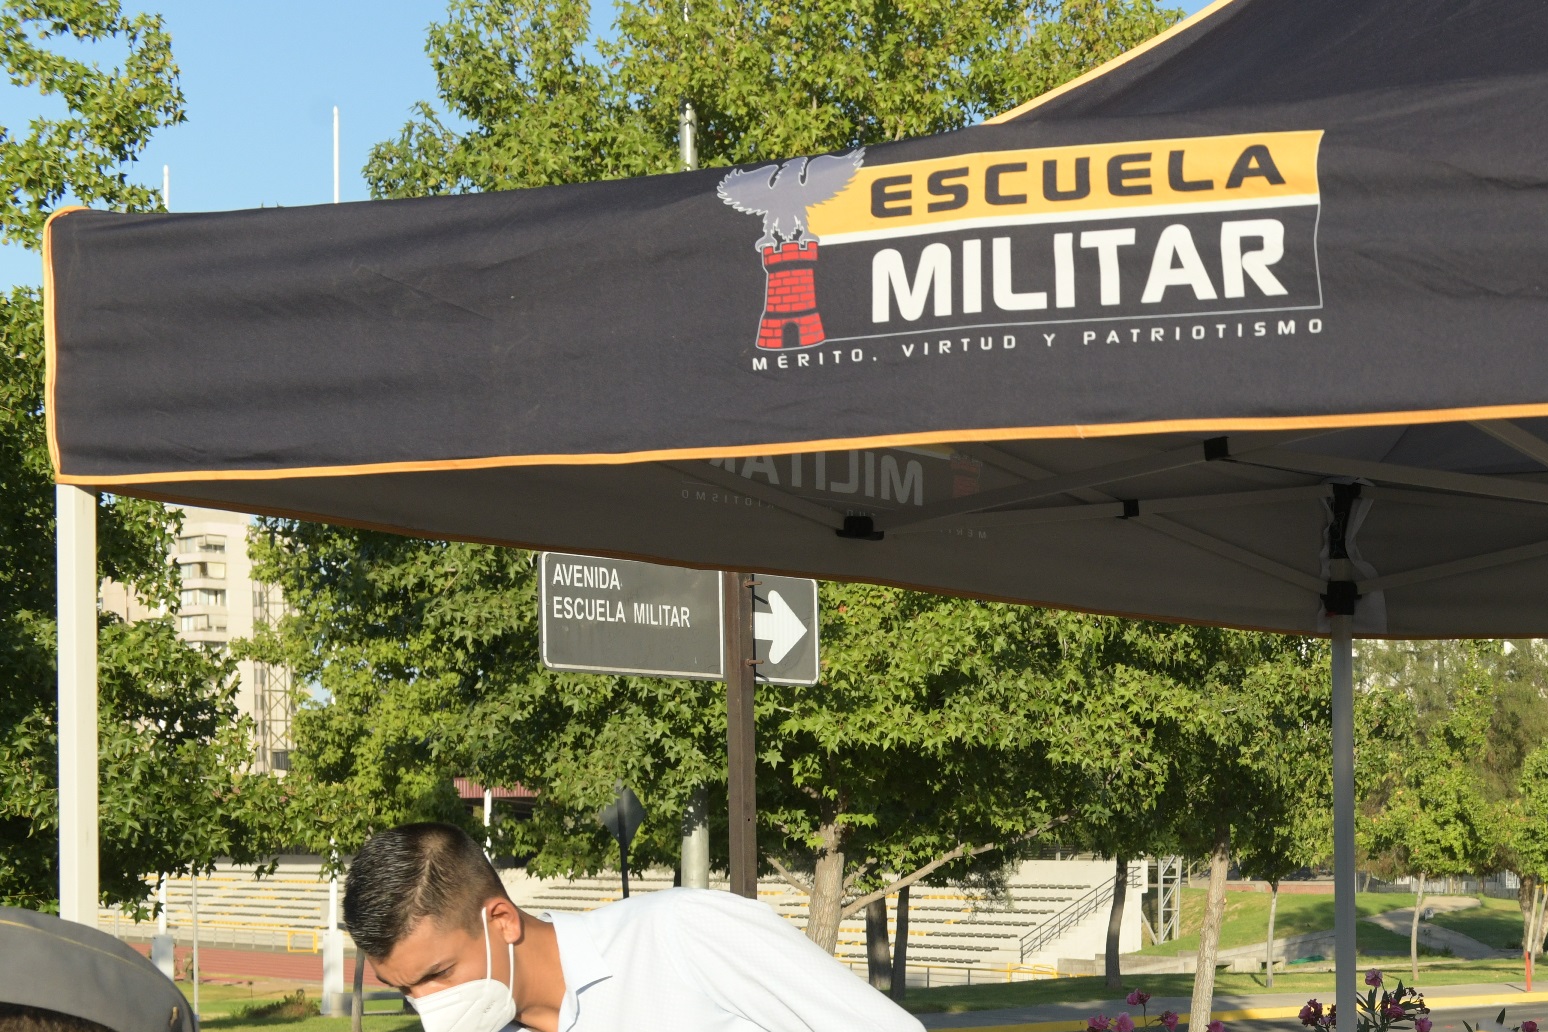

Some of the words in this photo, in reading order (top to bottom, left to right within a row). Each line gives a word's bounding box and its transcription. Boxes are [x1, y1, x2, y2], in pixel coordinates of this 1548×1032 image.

[870, 145, 1286, 218] ESCUELA
[871, 218, 1288, 323] MILITAR
[902, 335, 1016, 357] VIRTUD
[1043, 333, 1056, 347] Y
[1083, 318, 1323, 345] PATRIOTISMO
[553, 563, 620, 590] AVENIDA
[553, 596, 626, 623] ESCUELA
[633, 602, 691, 628] MILITAR
